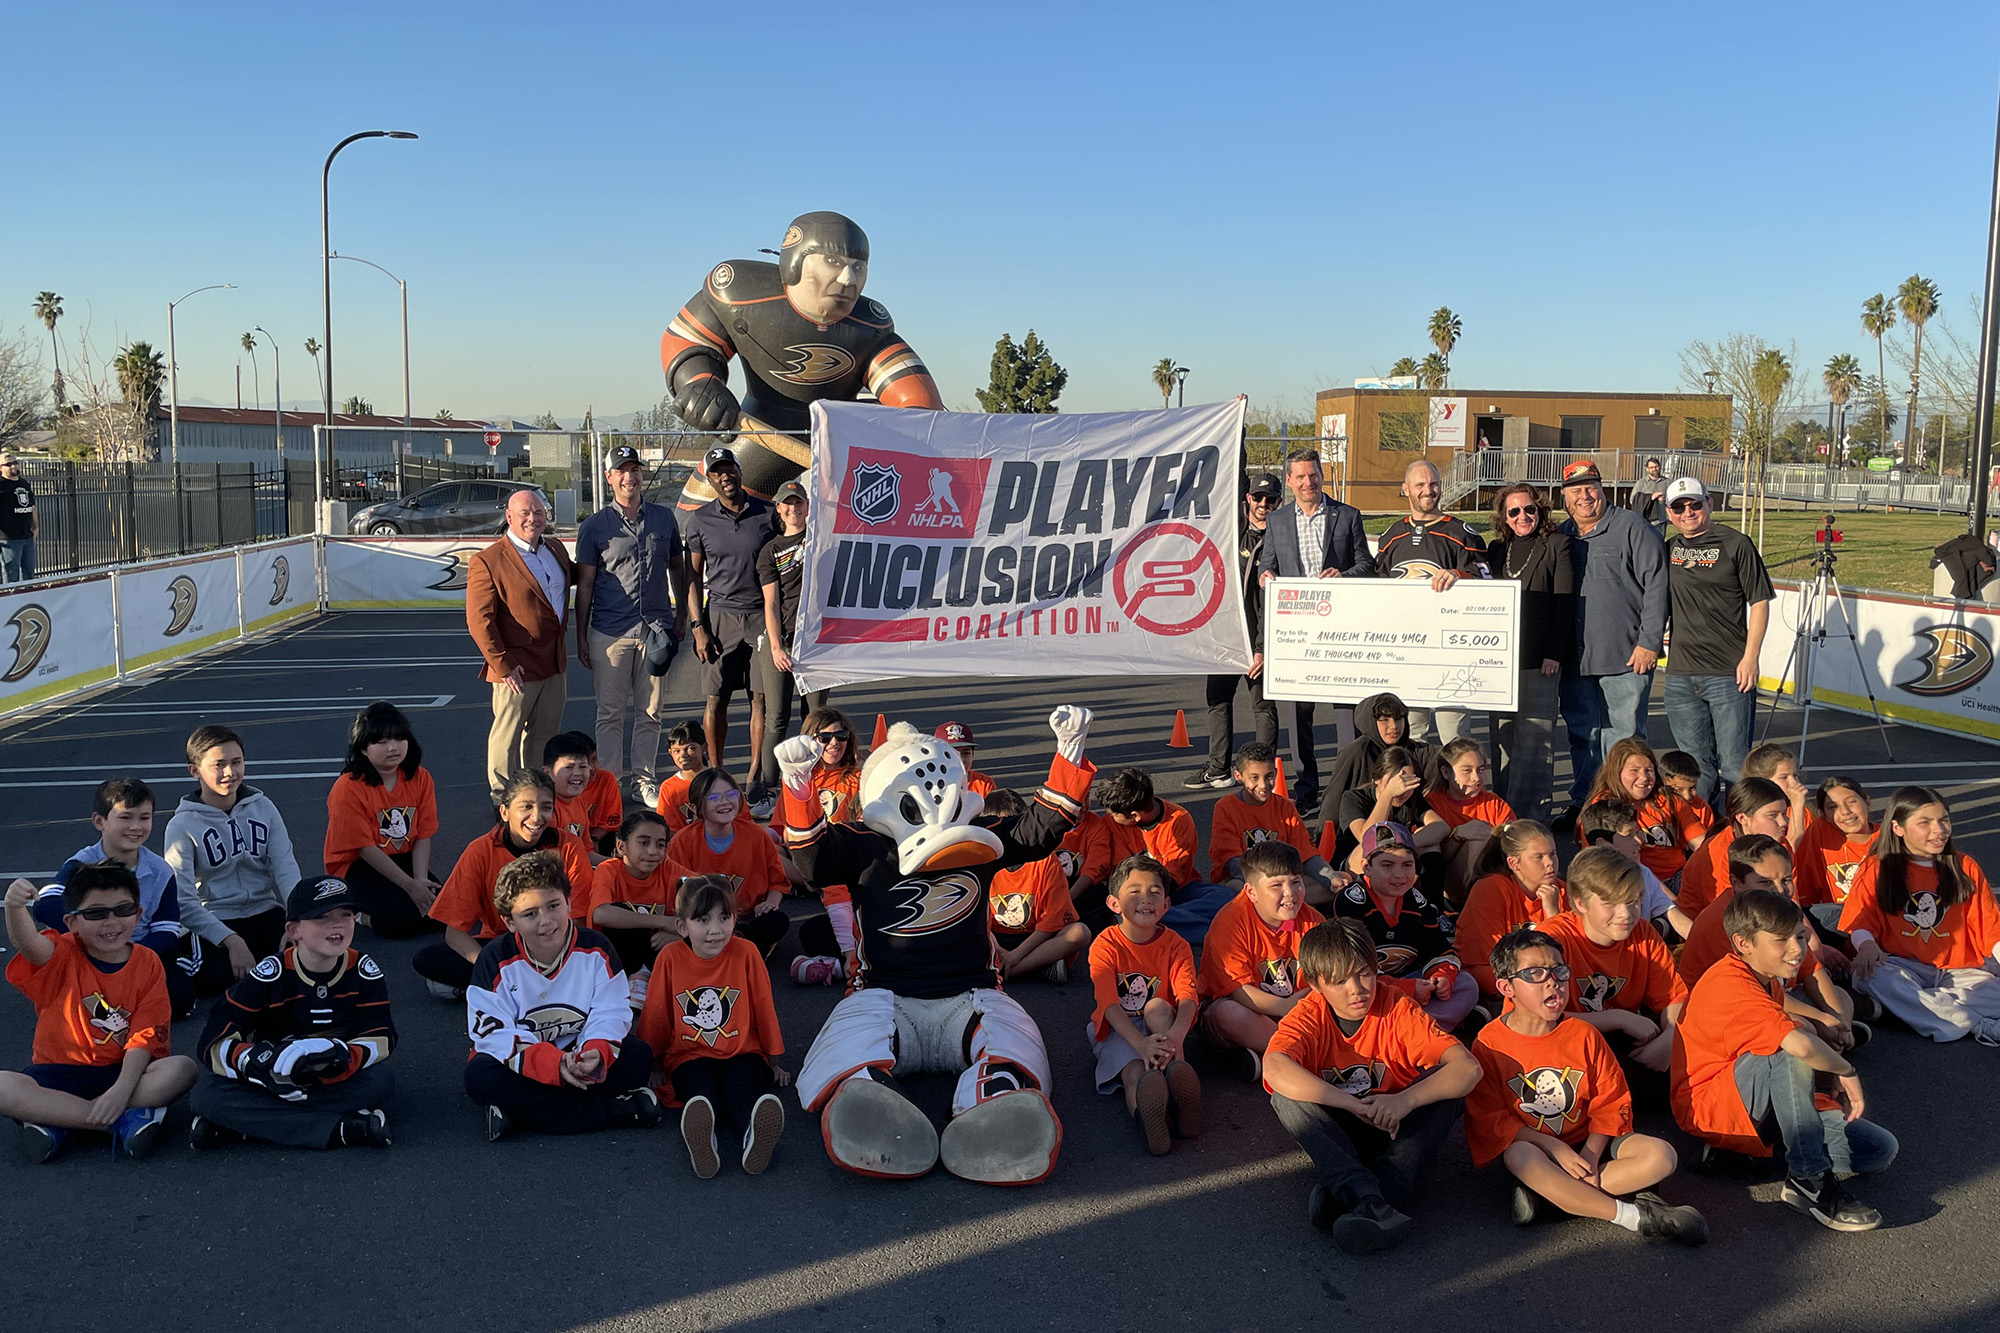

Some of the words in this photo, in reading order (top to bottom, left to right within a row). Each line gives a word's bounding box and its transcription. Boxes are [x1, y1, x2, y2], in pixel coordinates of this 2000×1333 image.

[861, 480, 892, 511] NHL
[987, 445, 1220, 537] PLAYER
[907, 513, 964, 528] NHLPA
[1671, 546, 1720, 561] DUCKS
[827, 538, 1112, 610] INCLUSION
[1299, 590, 1332, 601] PLAYER
[1277, 601, 1316, 610] INCLUSION
[933, 606, 1102, 641] COALITION
[1106, 621, 1120, 633] TM
[1275, 629, 1287, 637] Pay
[1316, 630, 1360, 641] ANAHEIM
[1364, 631, 1398, 643] FAMILY
[1401, 632, 1428, 645] YMCA
[1449, 634, 1500, 647] $5,000
[1304, 649, 1321, 658] FIVE
[1324, 649, 1364, 660] THOUSAND
[1366, 651, 1382, 660] AND
[1305, 674, 1331, 682] STREET
[1333, 676, 1358, 684] HOCKEY
[1961, 699, 1975, 708] UCI
[1977, 701, 2000, 713] Health
[202, 817, 269, 868] GAP
